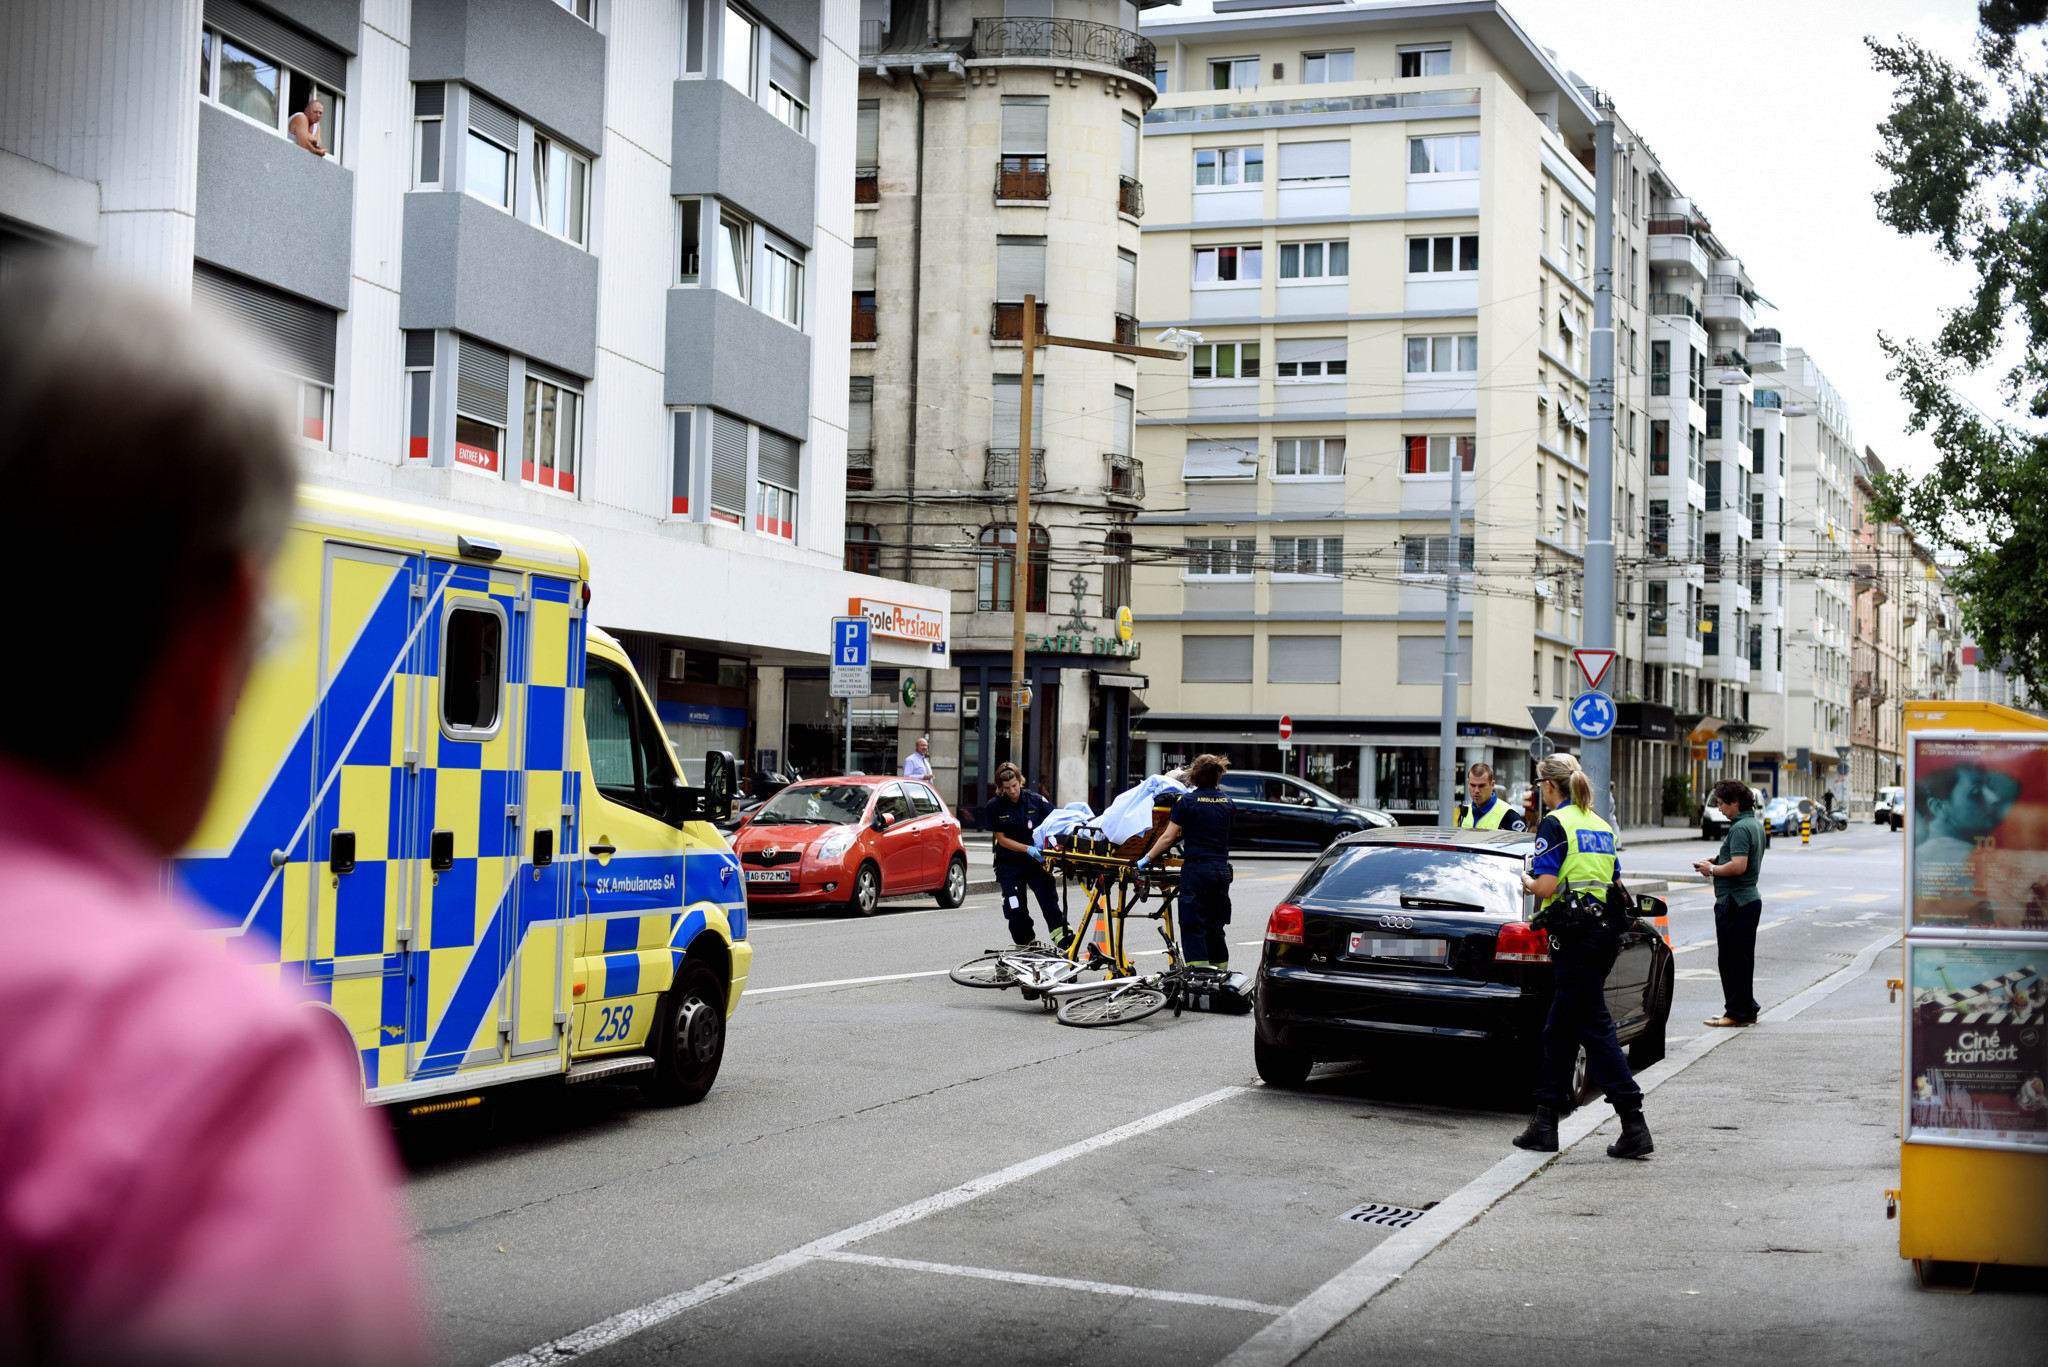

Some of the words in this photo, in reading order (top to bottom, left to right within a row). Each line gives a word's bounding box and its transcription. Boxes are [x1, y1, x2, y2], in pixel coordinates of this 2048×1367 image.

[892, 606, 941, 639] Persiaux
[845, 624, 859, 646] P
[1095, 636, 1118, 655] DE
[2029, 743, 2048, 751] Grang
[1581, 833, 1614, 852] POIC
[1973, 836, 1997, 852] TO
[595, 878, 610, 894] SK
[611, 876, 662, 893] Ambulances
[663, 874, 676, 890] SA
[1310, 953, 1327, 962] A3
[594, 1004, 634, 1042] 258
[1958, 1029, 2000, 1050] Ciné
[1944, 1043, 2019, 1064] transat
